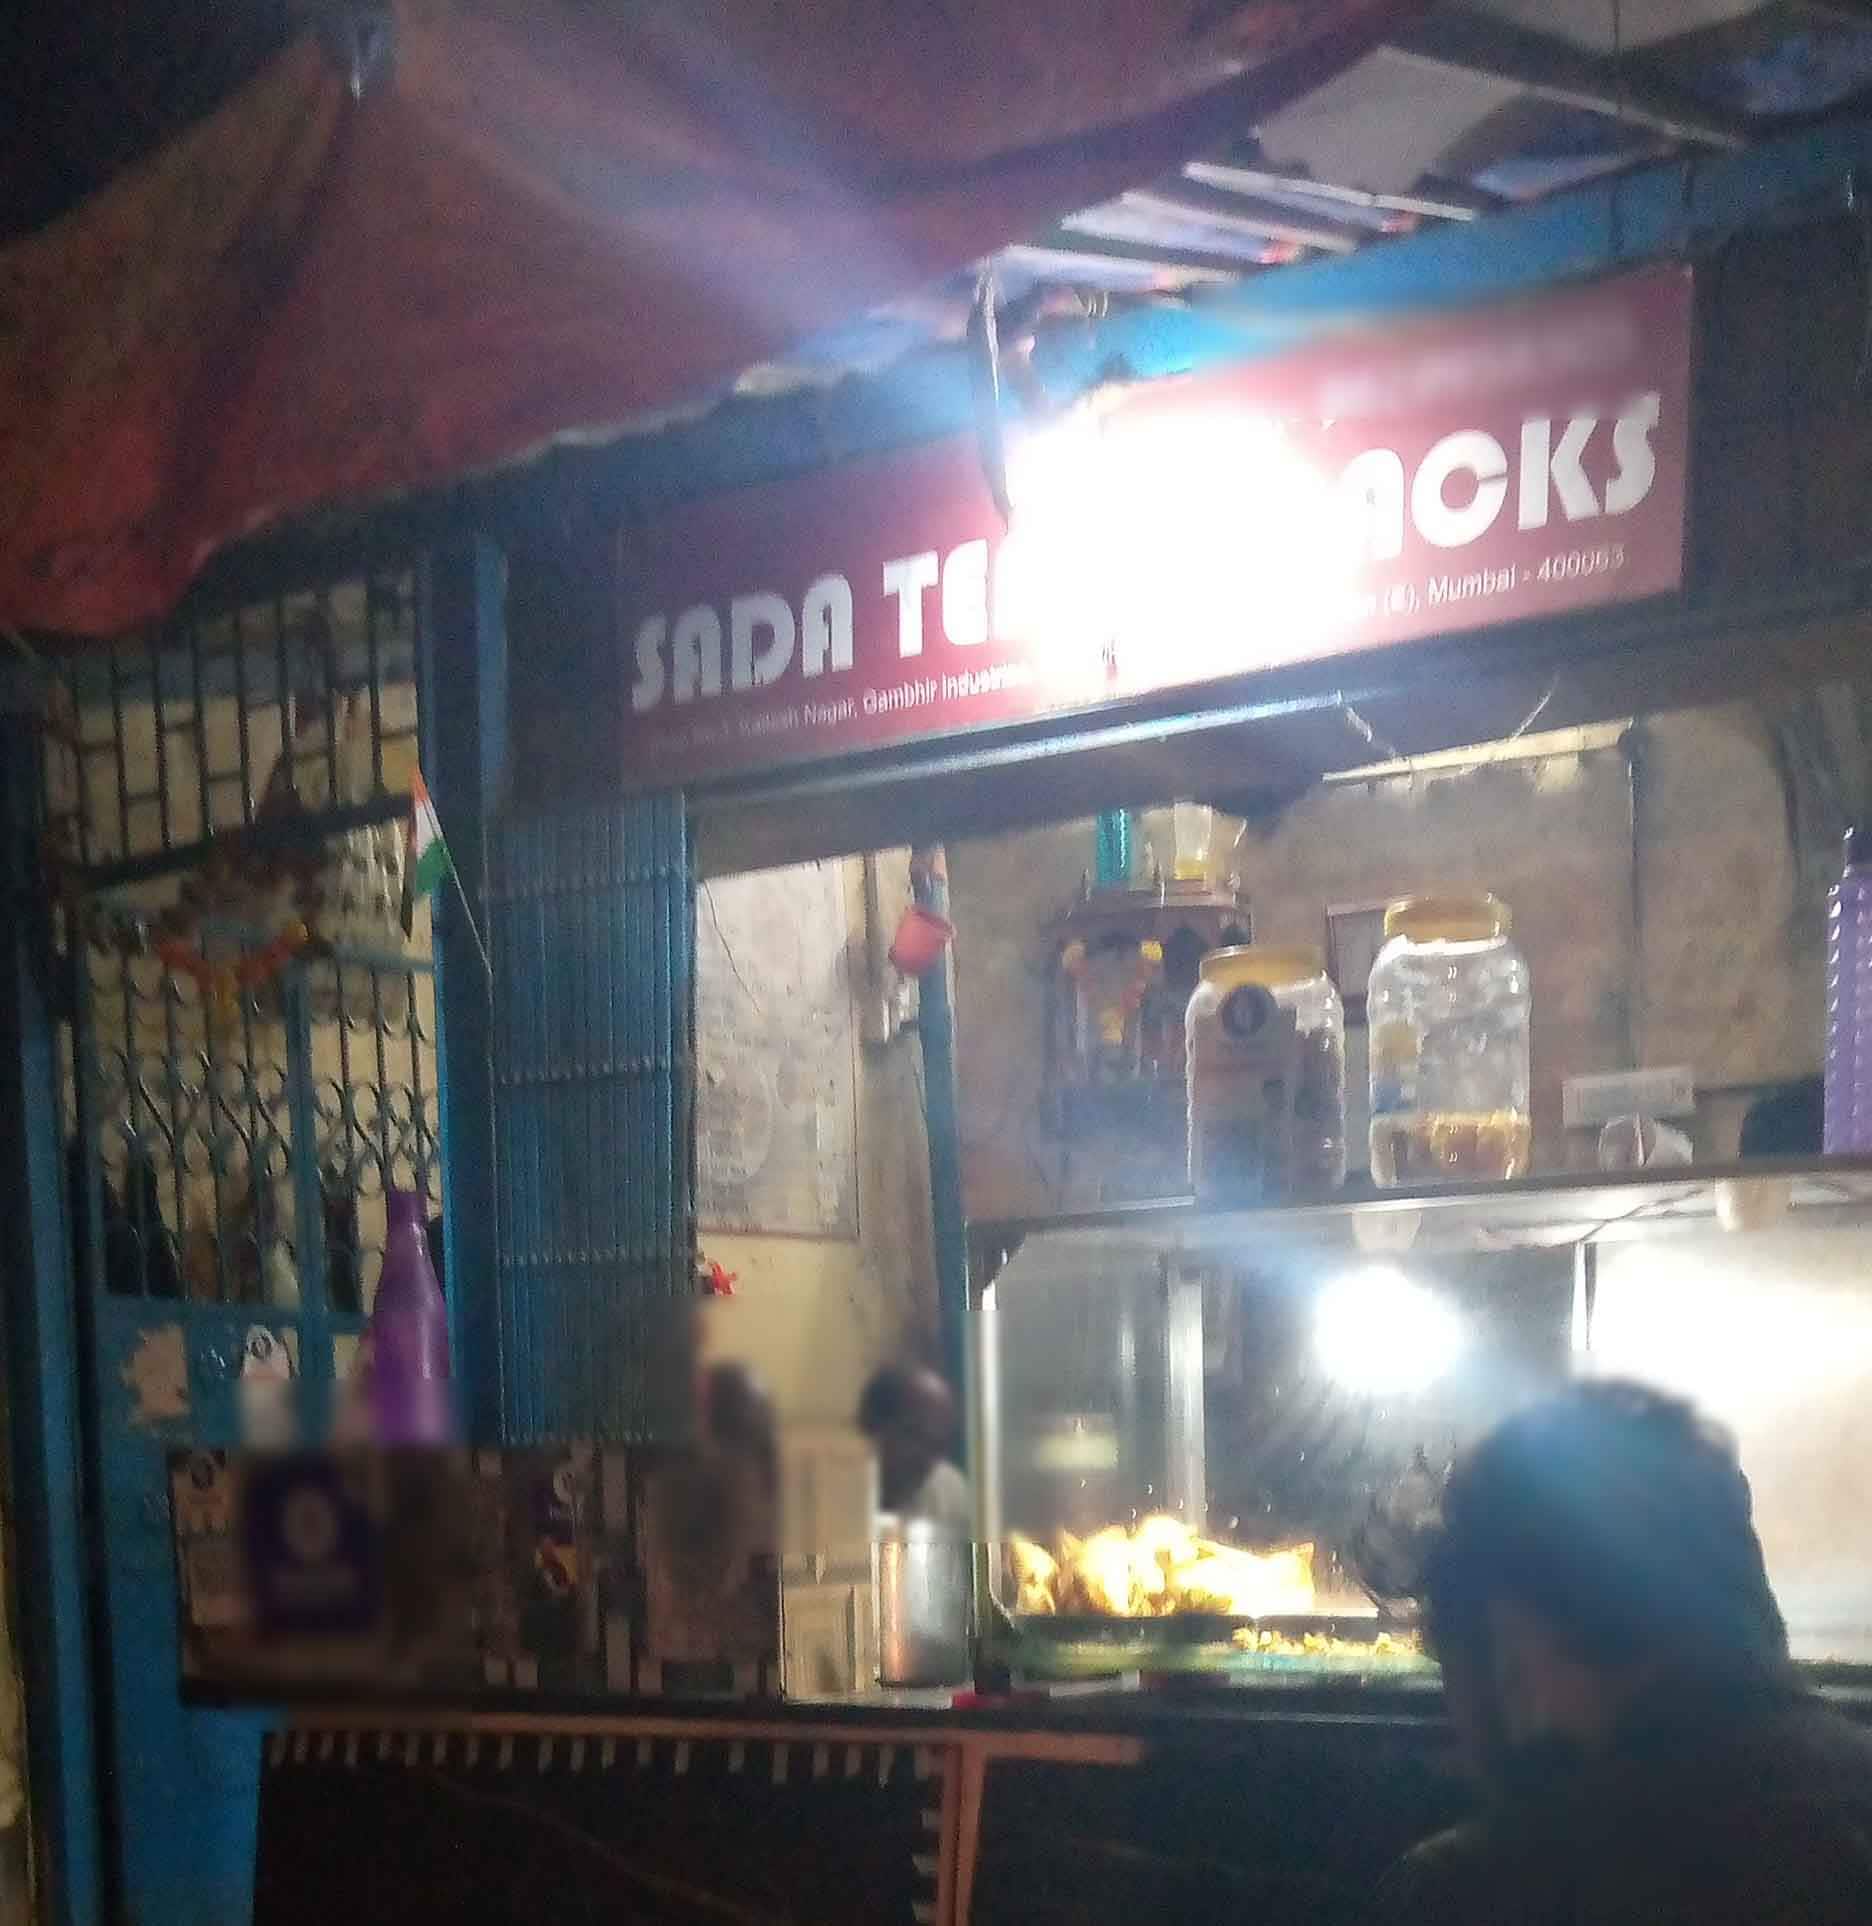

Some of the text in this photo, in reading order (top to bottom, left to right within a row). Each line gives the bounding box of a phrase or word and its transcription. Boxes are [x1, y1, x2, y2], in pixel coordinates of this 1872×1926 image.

[631, 393, 1661, 712] SADA TE ACKS
[1427, 564, 1516, 609] Mumbai
